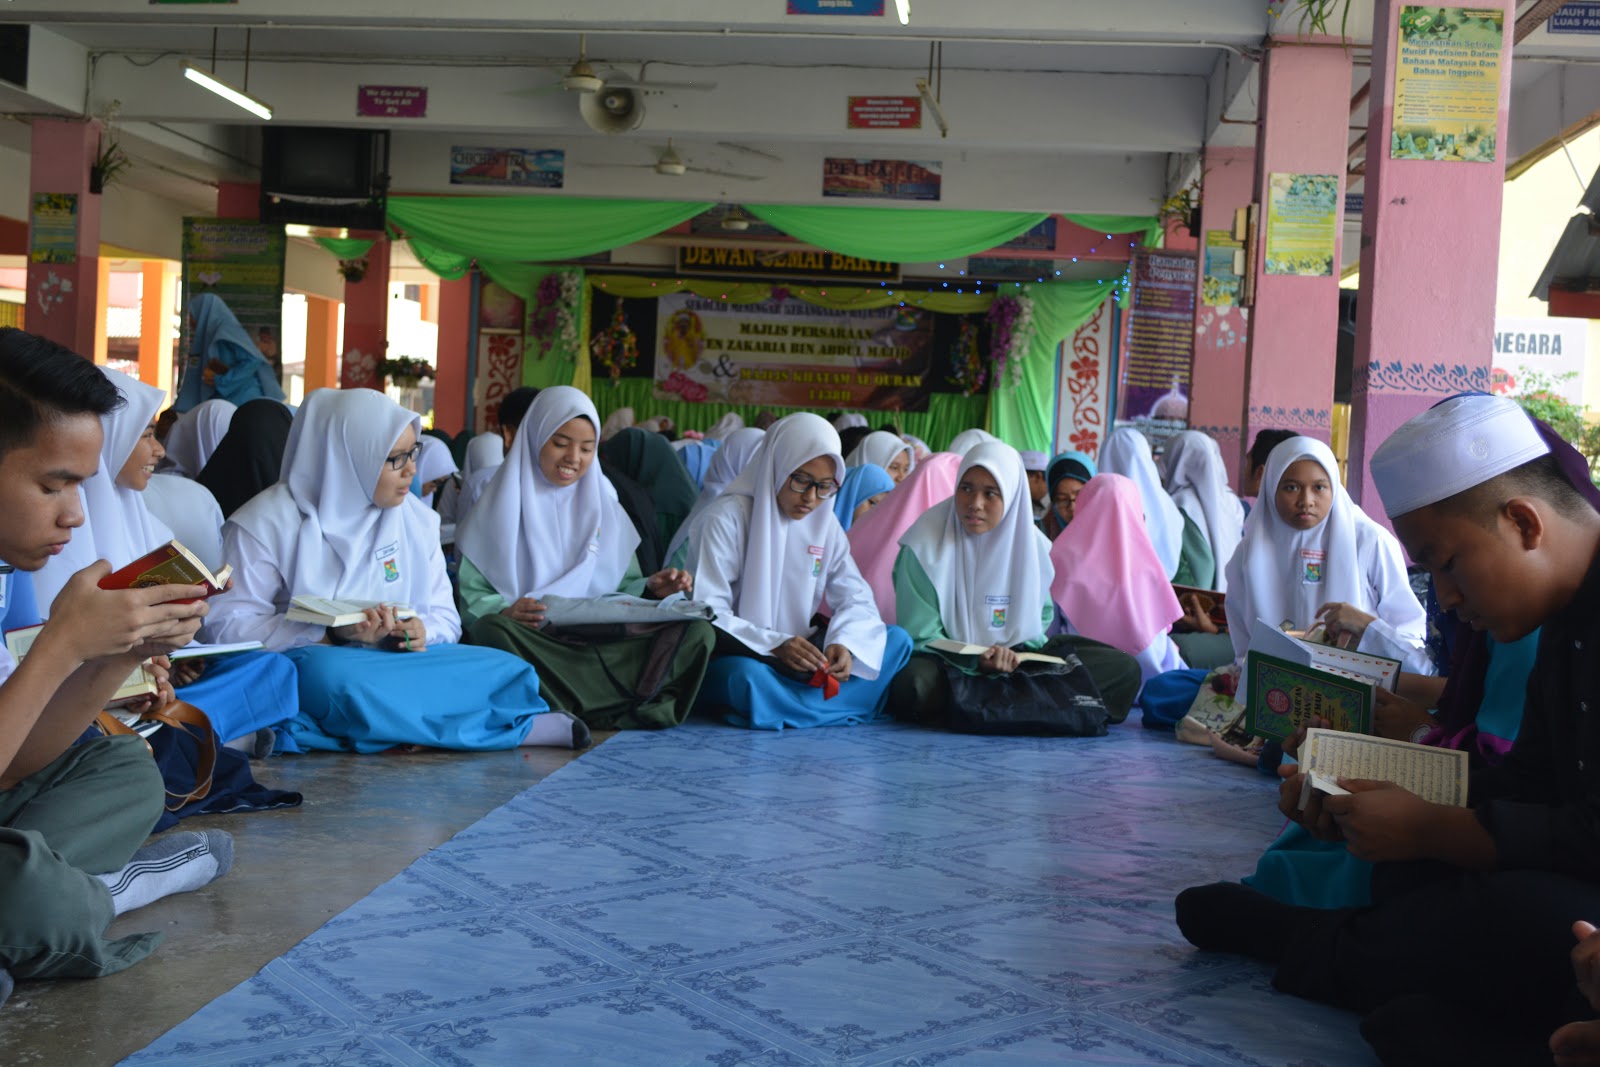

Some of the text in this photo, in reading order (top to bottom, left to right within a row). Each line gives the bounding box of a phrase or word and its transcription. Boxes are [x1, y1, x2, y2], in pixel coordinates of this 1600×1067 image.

[1555, 8, 1600, 17] JAUH BE
[1554, 18, 1580, 26] LUAS
[1408, 38, 1462, 47] Memastikan
[1429, 48, 1468, 56] Profisien
[1470, 50, 1498, 58] Dalam
[1402, 57, 1497, 68] Bahasa Malaysia Dan
[1413, 67, 1485, 77] Bahasa Inggeris
[685, 246, 755, 267] DEWAN
[740, 322, 874, 340] MAJLIS PERSARAAN
[706, 338, 722, 350] EN
[727, 339, 787, 353] ZAKARIA
[791, 342, 815, 354] BIN
[820, 343, 864, 356] ABDUL
[1493, 332, 1562, 355] NEGARA
[712, 353, 737, 378] &
[740, 367, 788, 382] MAJLIS
[1303, 702, 1312, 719] DAN
